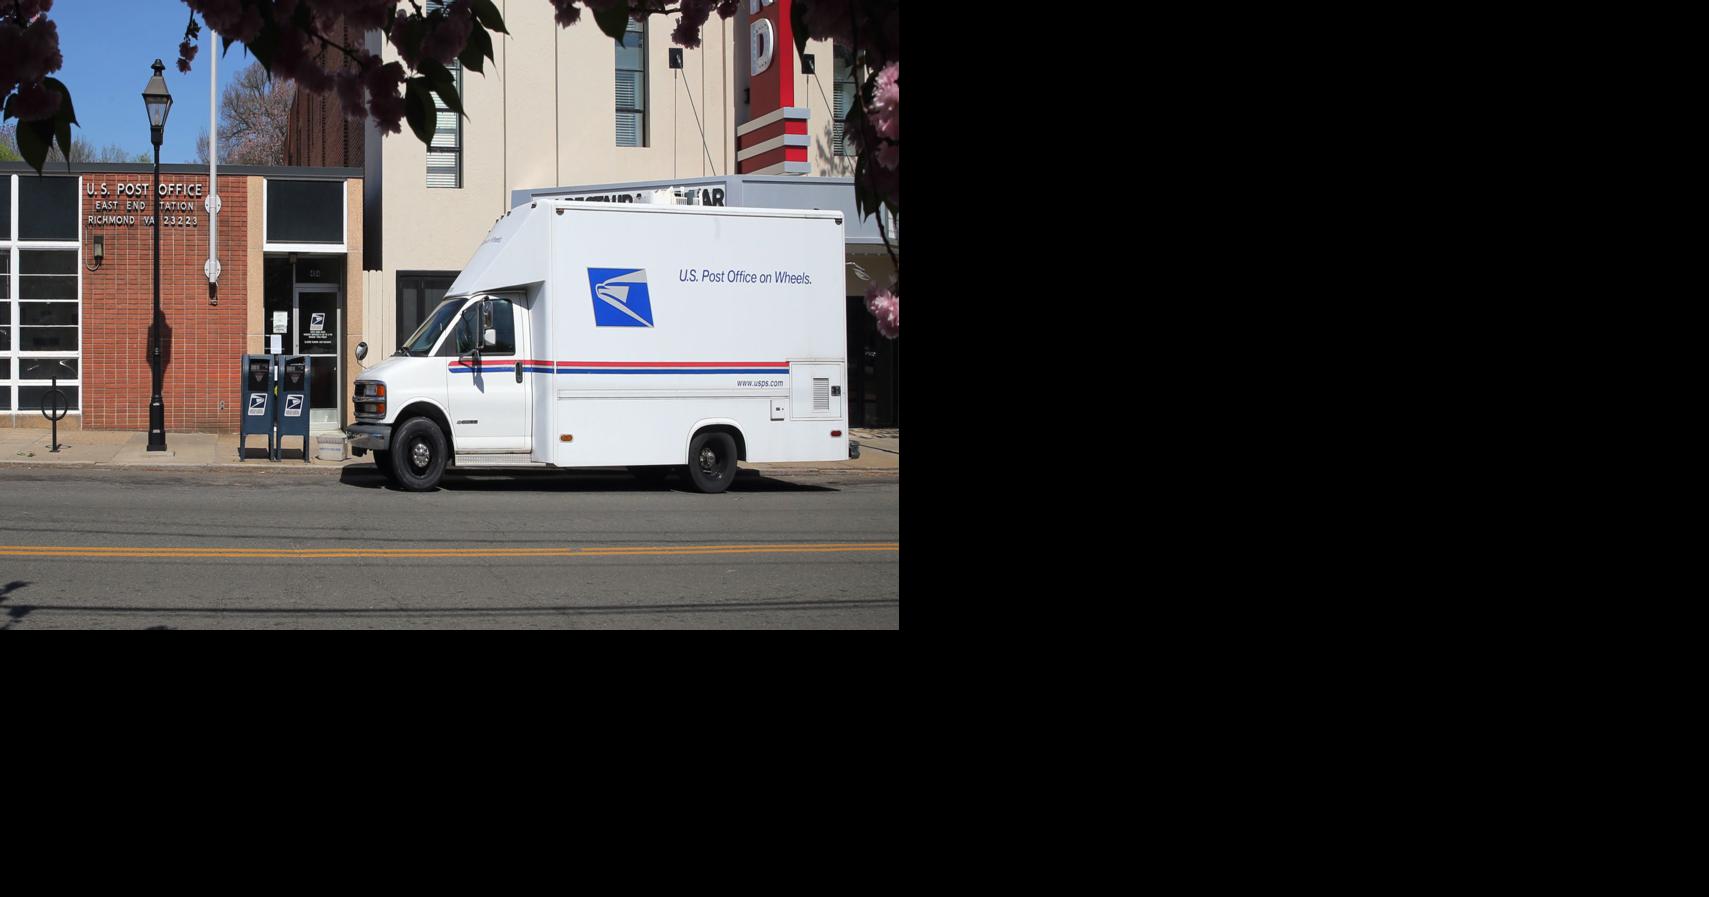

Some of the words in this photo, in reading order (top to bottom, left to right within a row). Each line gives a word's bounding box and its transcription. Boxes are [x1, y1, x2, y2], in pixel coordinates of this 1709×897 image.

[117, 183, 149, 195] POST
[158, 183, 202, 196] OFFICE
[95, 201, 118, 210] EAST
[126, 201, 146, 210] END
[154, 201, 194, 210] TATION
[88, 215, 135, 225] RICHMOND
[143, 216, 155, 224] VA
[163, 216, 198, 225] 23223
[679, 268, 699, 282] U.S.
[701, 269, 725, 283] Post
[727, 269, 757, 284] Office
[759, 272, 772, 284] on
[774, 271, 812, 285] Wheels.
[737, 380, 784, 388] www.usps.com
